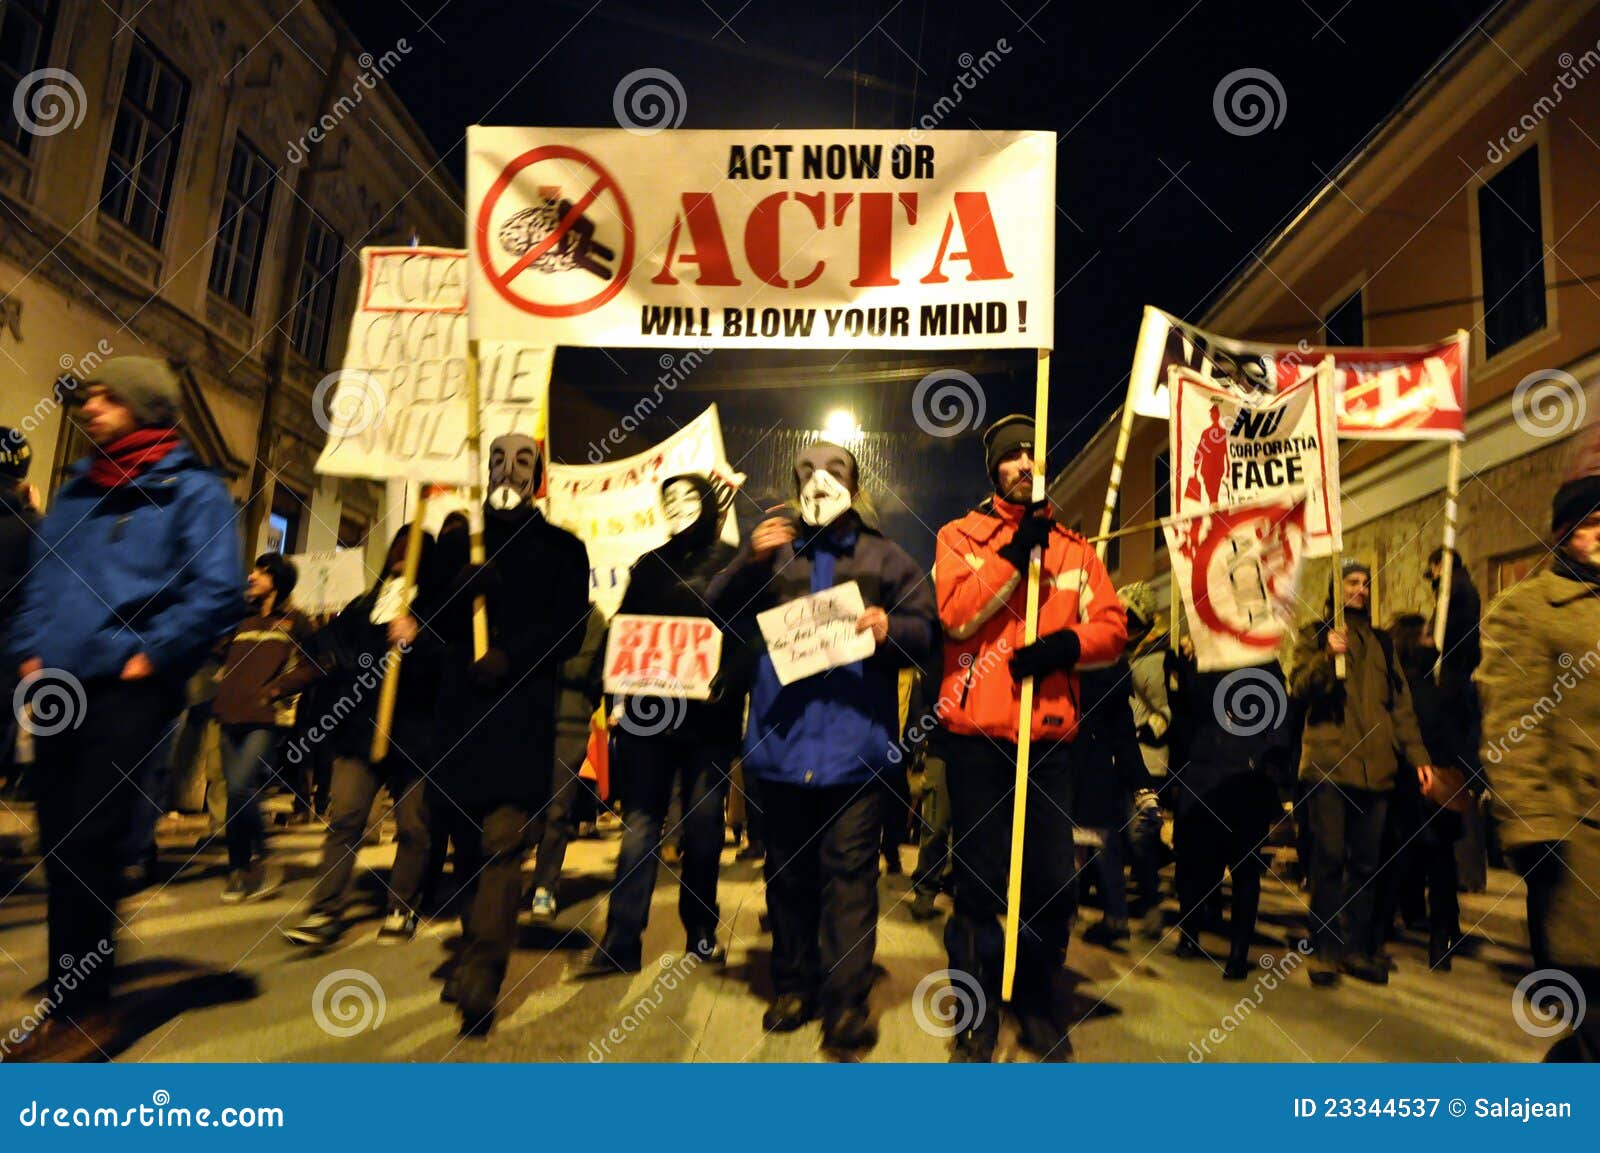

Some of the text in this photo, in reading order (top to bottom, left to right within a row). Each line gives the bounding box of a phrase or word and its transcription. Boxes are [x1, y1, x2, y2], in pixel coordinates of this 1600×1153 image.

[728, 144, 935, 180] ACT NOW OR
[651, 191, 1014, 289] ACTA
[374, 254, 463, 304] ACTA
[641, 305, 713, 336] WILL
[723, 306, 815, 337] BLOW
[824, 305, 909, 338] YOUR
[920, 302, 1008, 337] MIND
[1230, 404, 1288, 440] NU
[1231, 455, 1304, 490] FACE
[618, 620, 712, 650] STOP
[610, 650, 710, 680] ACTA
